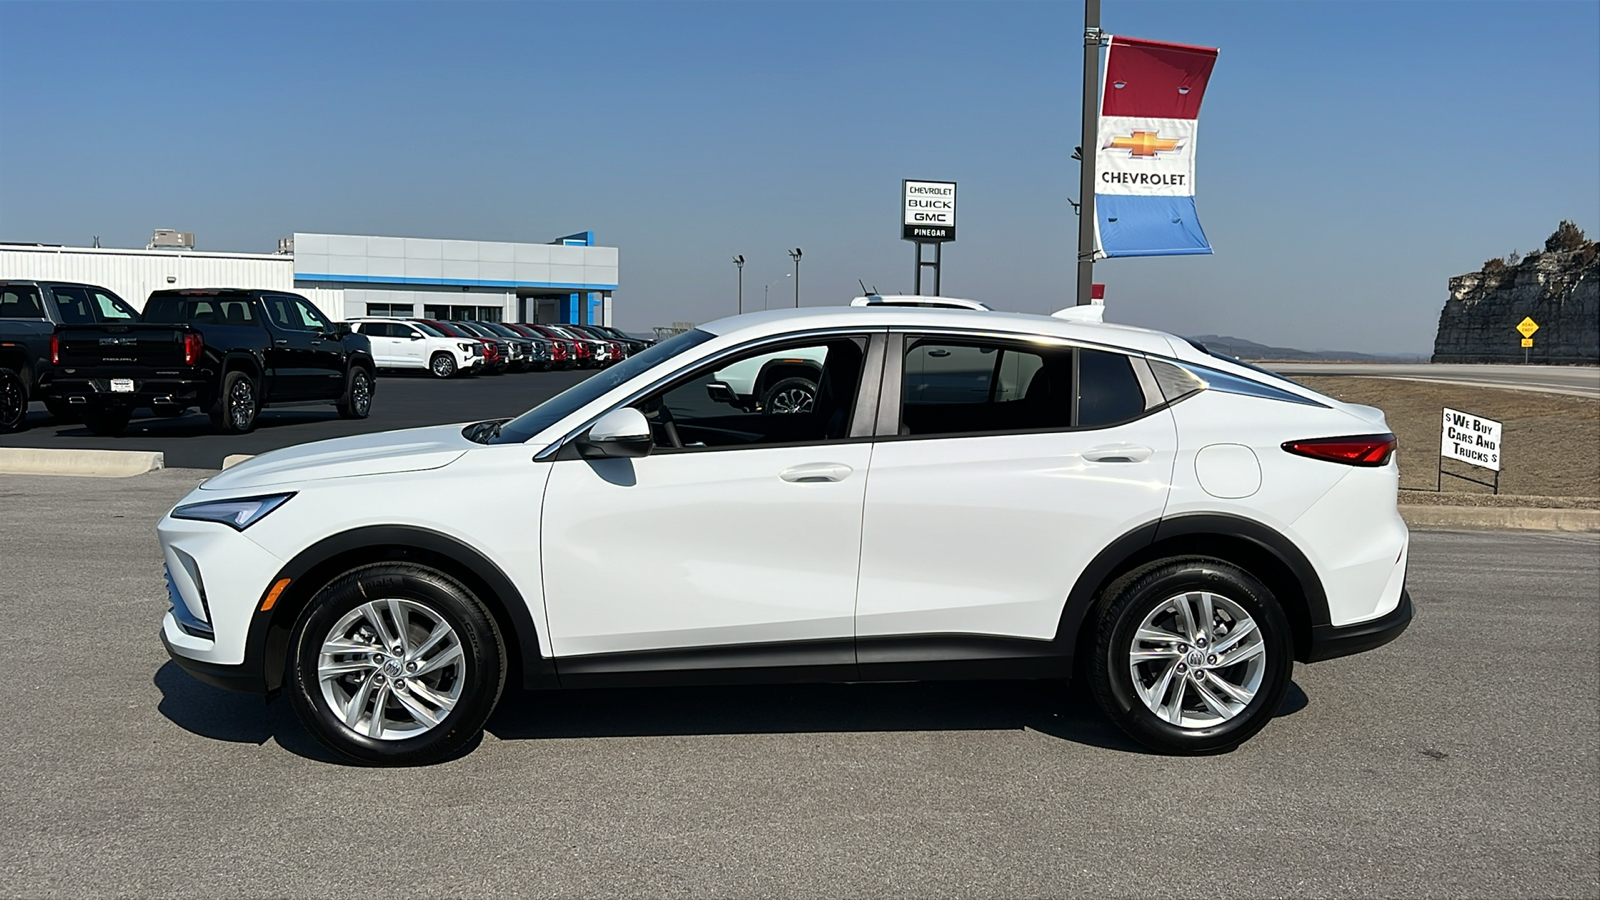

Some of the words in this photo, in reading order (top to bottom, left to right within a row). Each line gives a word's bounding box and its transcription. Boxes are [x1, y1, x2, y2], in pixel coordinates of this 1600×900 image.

[1101, 171, 1185, 185] CHEVROLET
[909, 186, 952, 195] CHEVROLET
[908, 199, 952, 209] BUICK
[914, 212, 946, 222] GMC
[914, 228, 946, 237] PINEGAR
[1447, 426, 1473, 444] CARS
[1475, 434, 1495, 450] AND
[1452, 441, 1488, 463] TRUCKS
